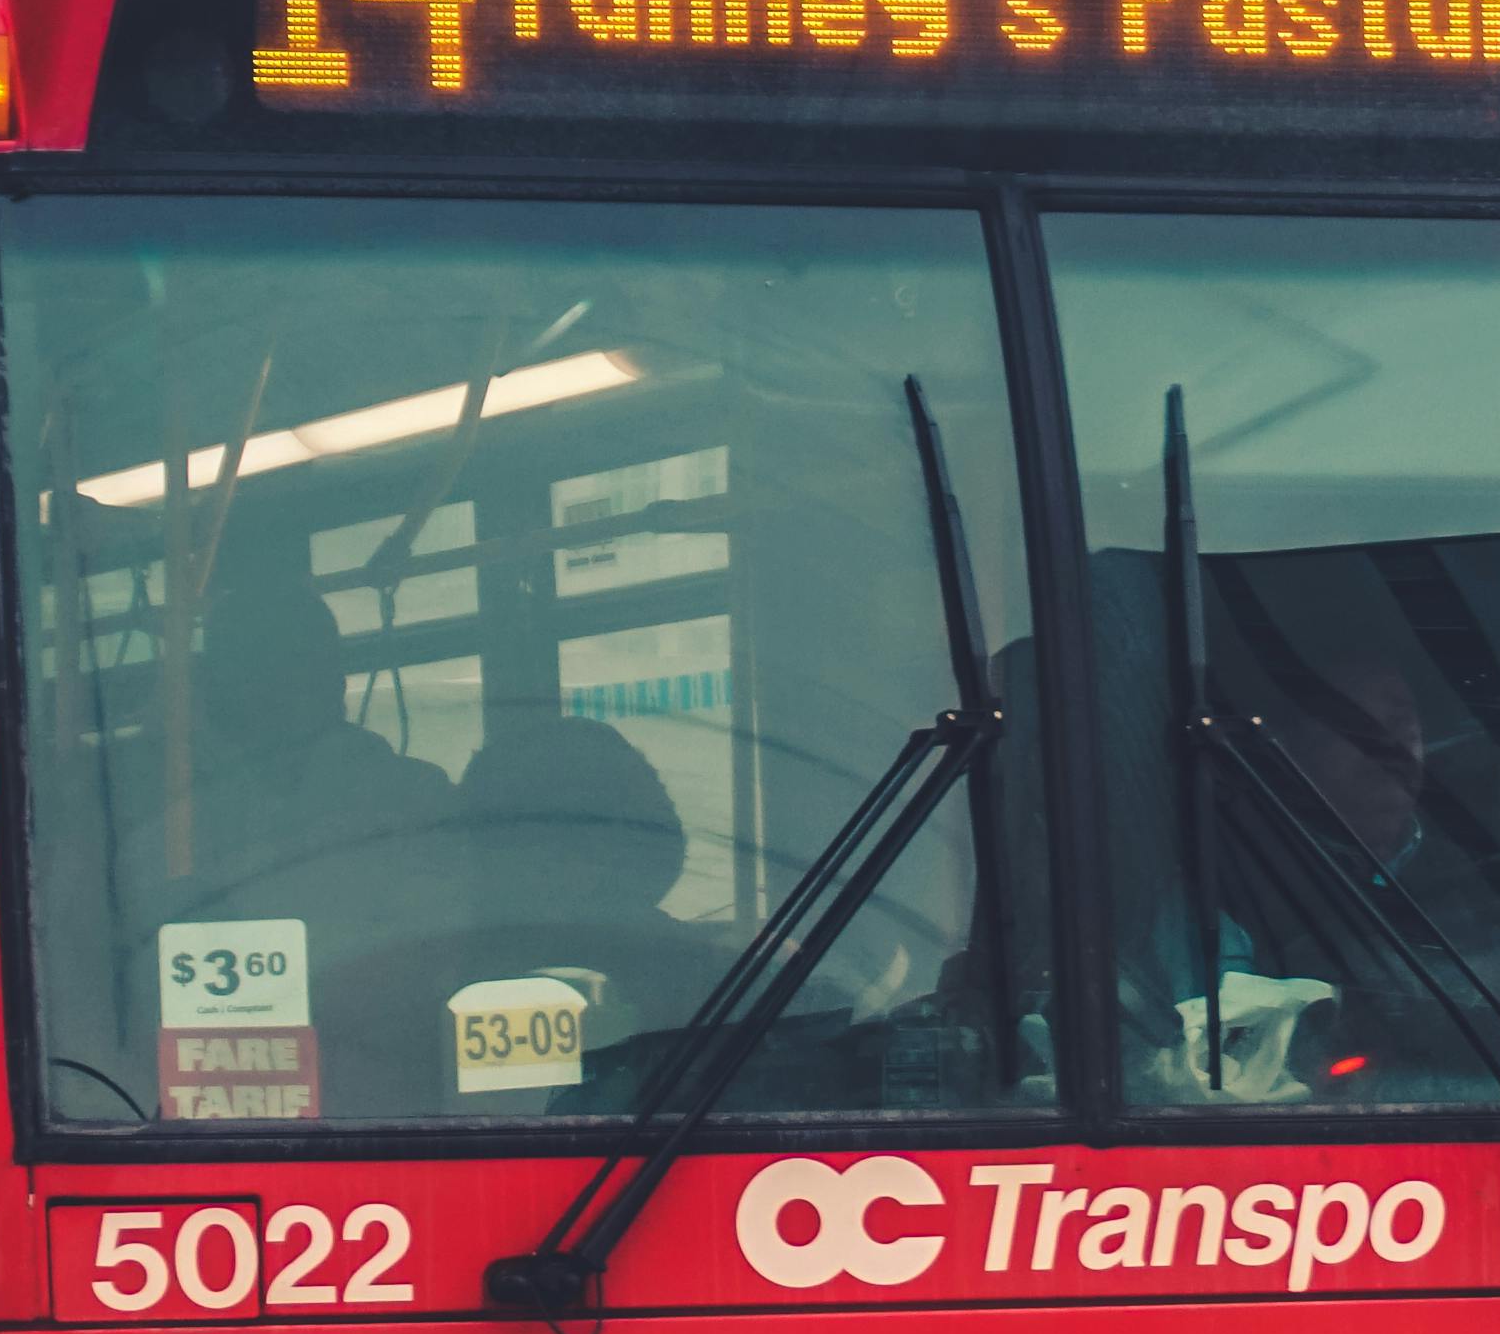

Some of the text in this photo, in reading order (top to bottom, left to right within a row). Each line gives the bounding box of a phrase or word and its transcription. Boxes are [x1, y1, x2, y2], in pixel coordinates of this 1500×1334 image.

[176, 1037, 300, 1073] FARE
[463, 1009, 579, 1062] 53-09
[167, 1084, 313, 1120] TARIF
[735, 1155, 1446, 1293] OC Transpo
[90, 1202, 415, 1312] 5022
